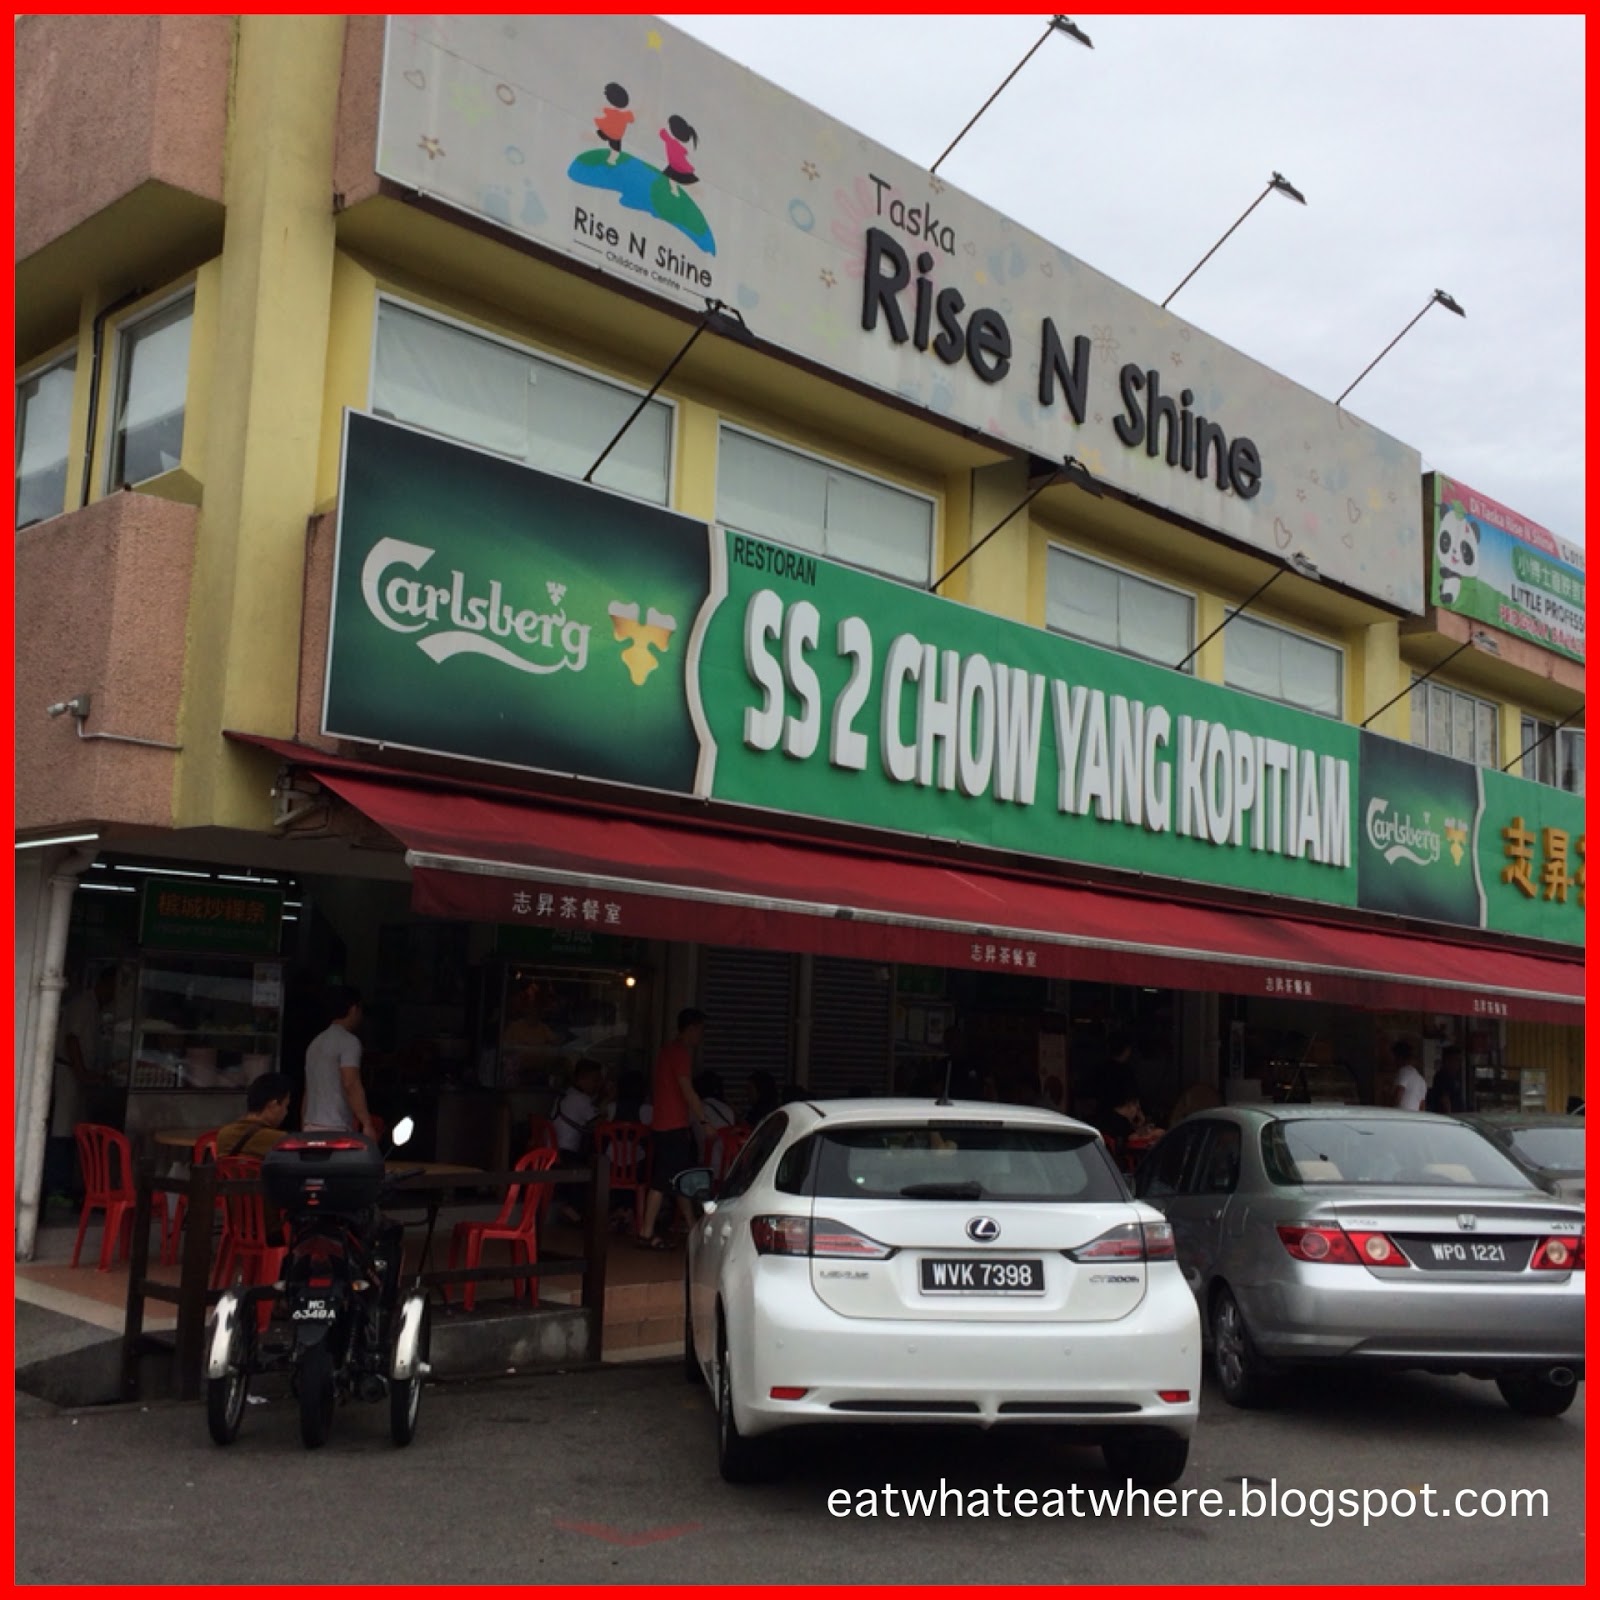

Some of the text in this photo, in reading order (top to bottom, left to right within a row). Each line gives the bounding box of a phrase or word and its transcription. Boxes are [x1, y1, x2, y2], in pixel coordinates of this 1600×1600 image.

[574, 206, 712, 287] Rise N Shine
[869, 173, 955, 255] Taska
[606, 251, 680, 289] Childcare Centre
[862, 227, 1261, 499] Rise N Shine
[733, 537, 818, 586] RESTORAN
[361, 537, 592, 675] Carlsberg
[1511, 584, 1542, 613] LITTLE
[744, 588, 1351, 869] SS 2 CHOW YANG KOPITIAM
[1366, 797, 1441, 866] Carlsberg
[1502, 816, 1584, 908] 志昇
[512, 890, 622, 925] 志昇茶餐室
[931, 1263, 1033, 1287] WVK 7398
[1470, 1243, 1506, 1262] 1221
